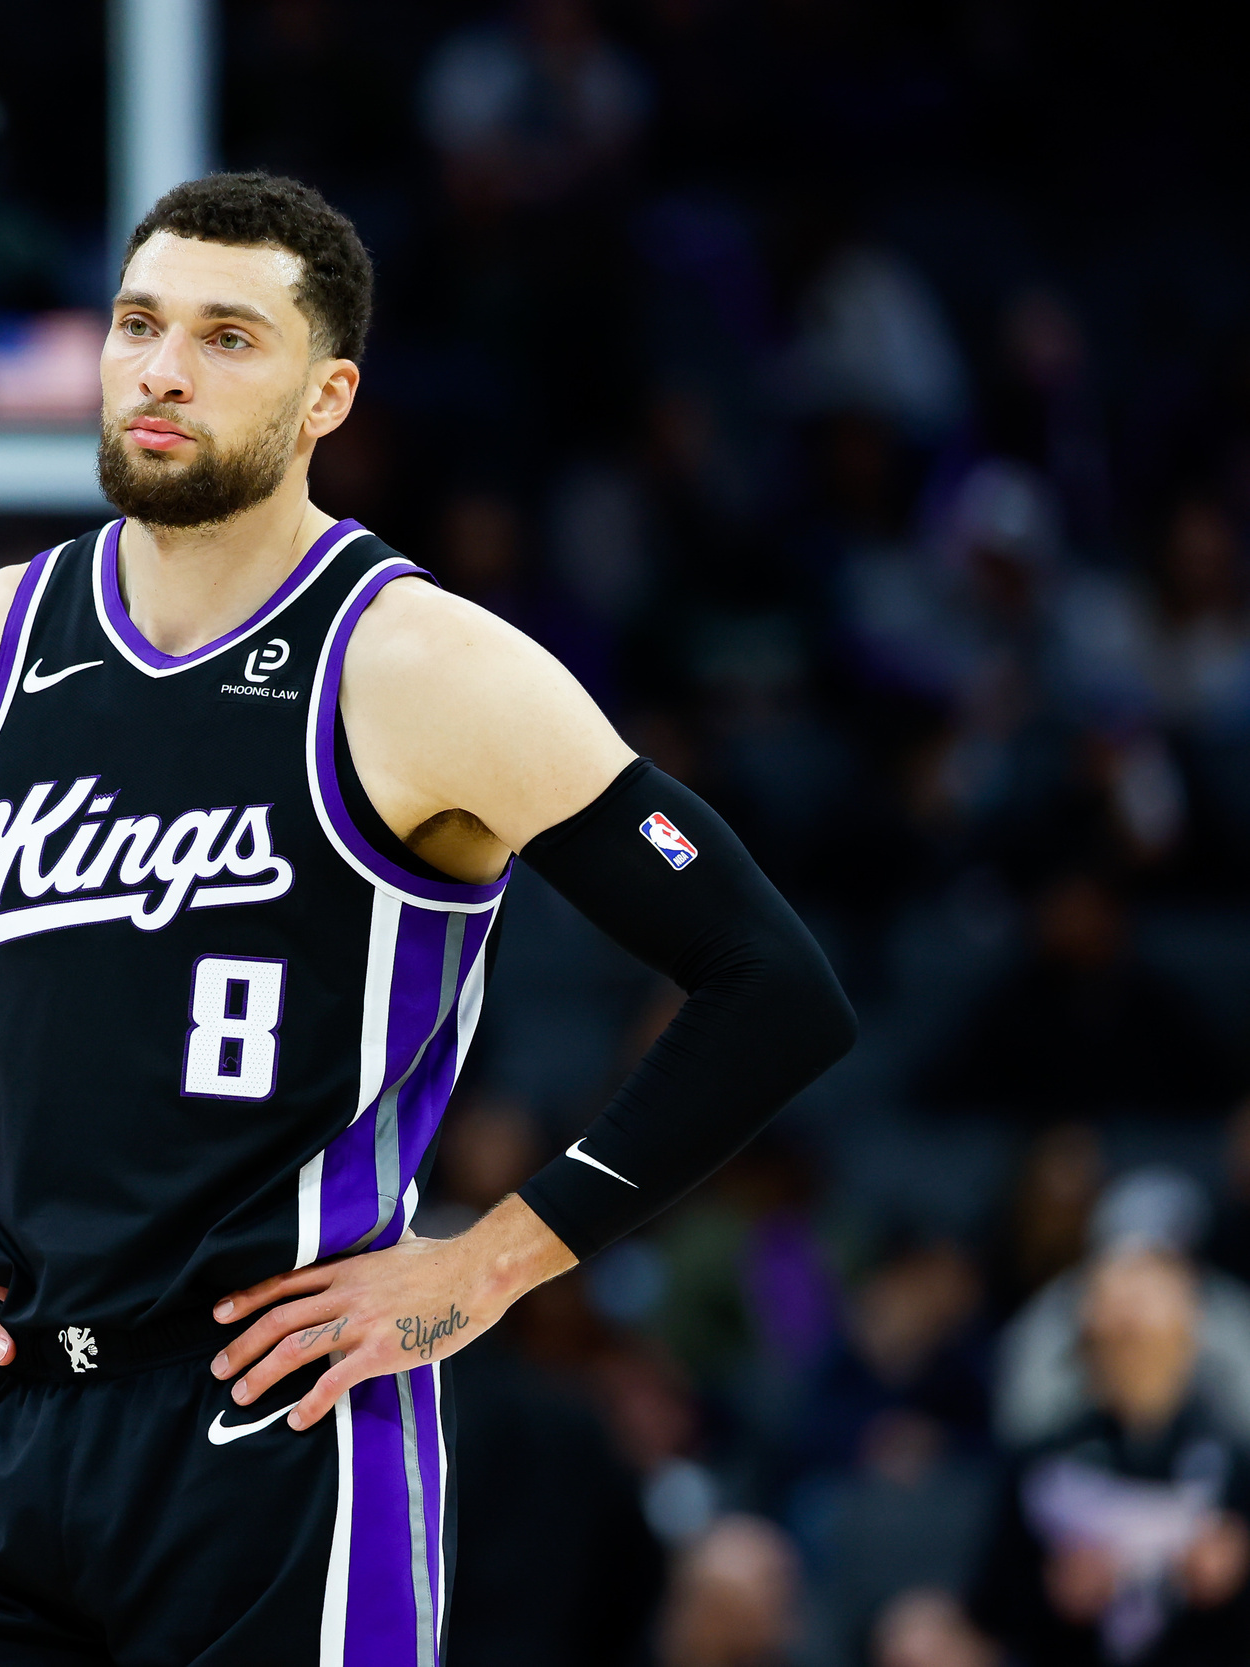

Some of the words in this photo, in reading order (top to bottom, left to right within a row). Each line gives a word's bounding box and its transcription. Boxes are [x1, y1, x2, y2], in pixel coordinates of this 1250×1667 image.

[220, 684, 270, 697] PHOONG
[271, 689, 299, 700] LAW
[672, 851, 689, 867] NBA
[180, 953, 288, 1102] 8
[396, 1303, 469, 1360] Elijah
